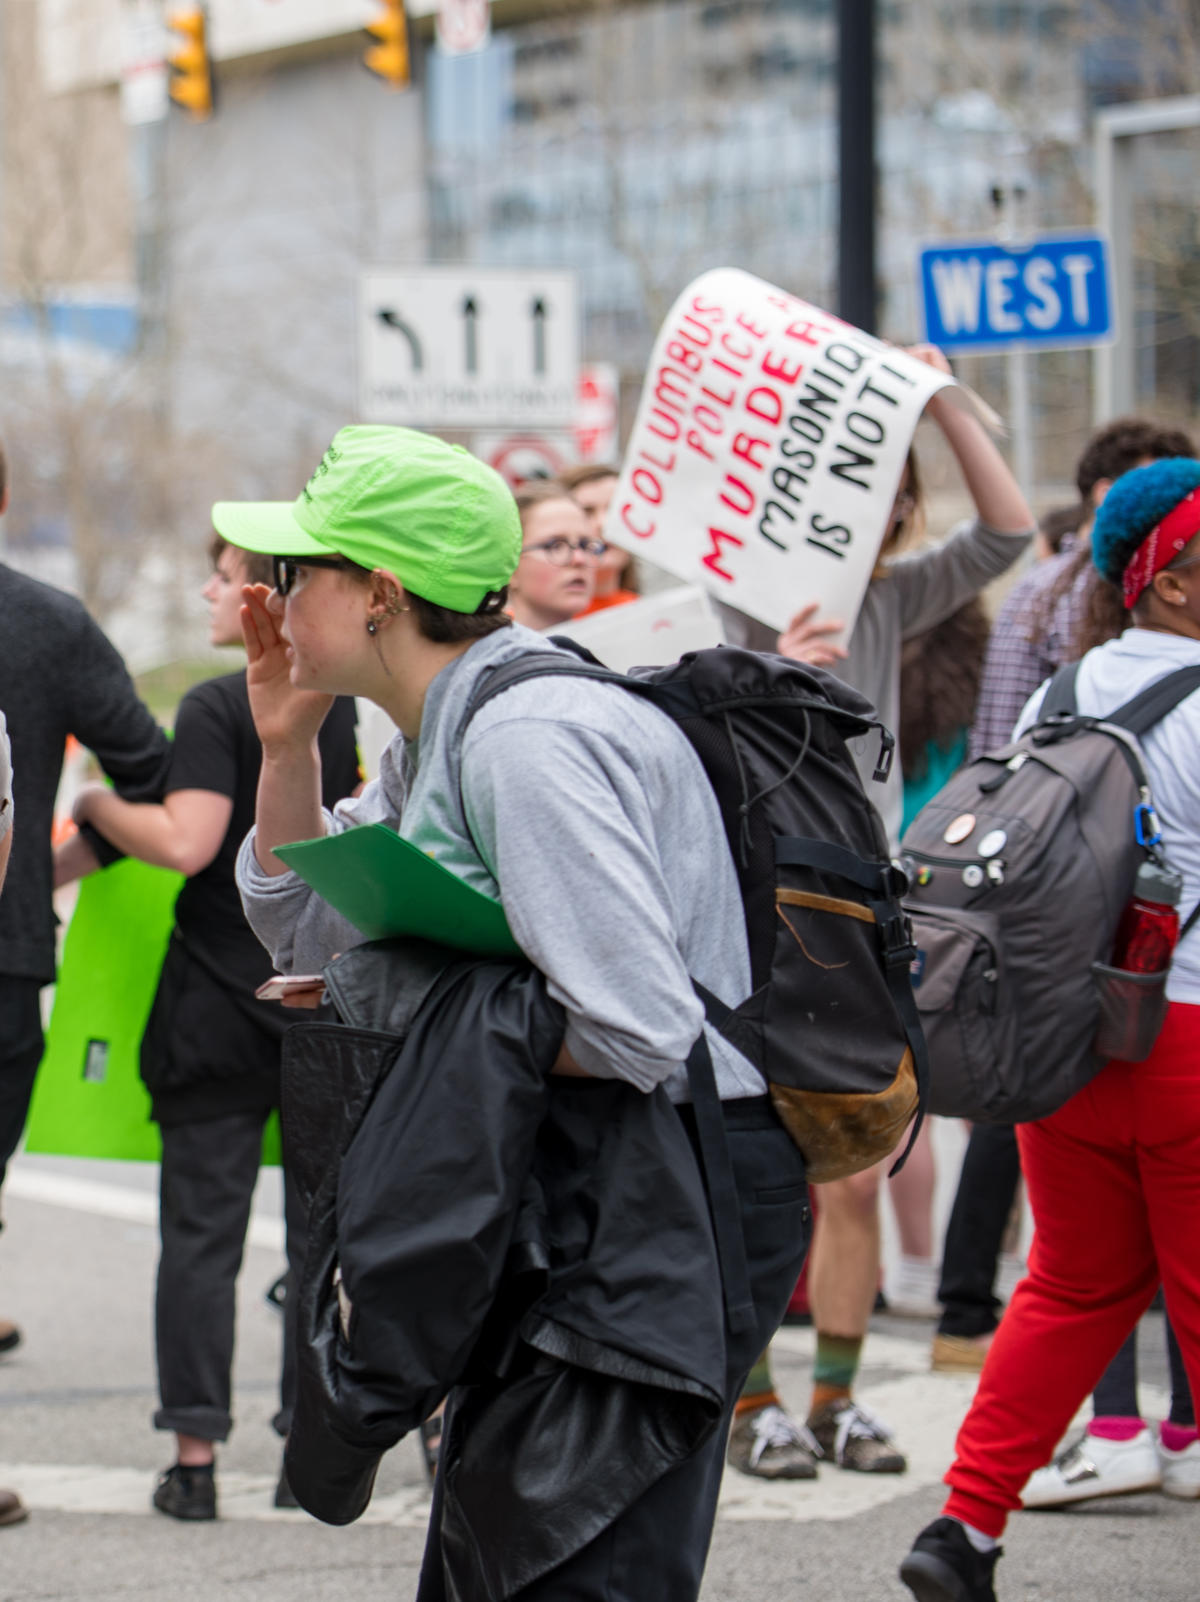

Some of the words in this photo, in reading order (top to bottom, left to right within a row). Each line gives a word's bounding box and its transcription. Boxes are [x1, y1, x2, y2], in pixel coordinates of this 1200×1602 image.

[930, 255, 1094, 334] WEST
[620, 296, 725, 539] COLUMBUS
[686, 311, 769, 463] POLICE
[806, 513, 852, 561] IS
